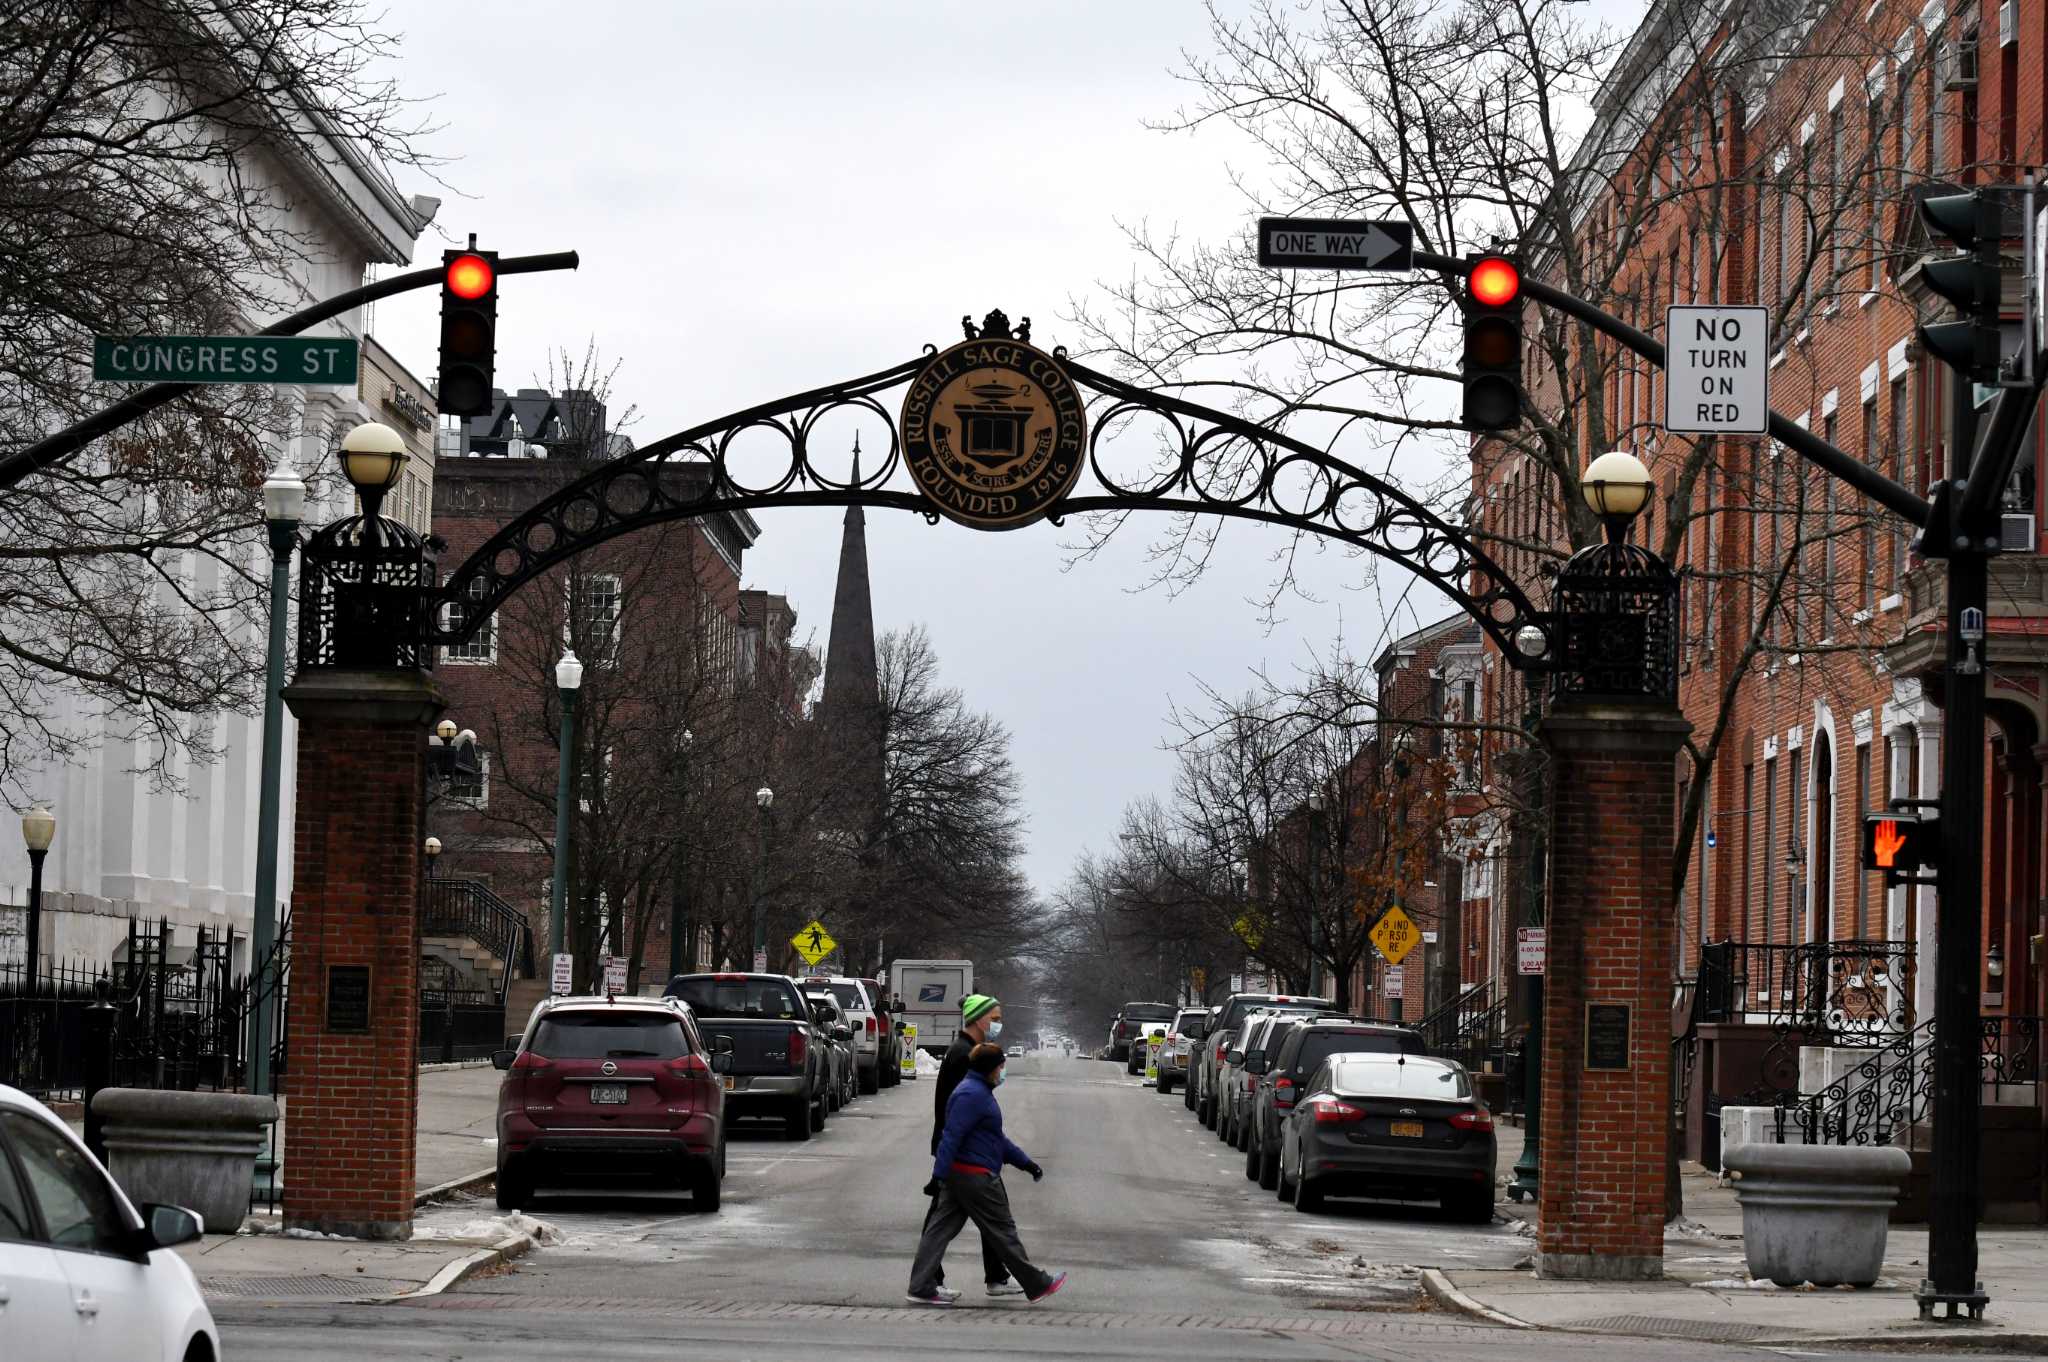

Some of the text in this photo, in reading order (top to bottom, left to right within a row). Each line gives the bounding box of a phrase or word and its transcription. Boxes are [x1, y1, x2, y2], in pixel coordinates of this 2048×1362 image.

[1276, 234, 1366, 254] ONE WAY
[1695, 317, 1741, 342] NO
[111, 344, 340, 375] CONGRESS ST
[1688, 349, 1747, 369] TURN
[1701, 376, 1734, 395] ON
[907, 346, 1080, 450] RUSSELL SAGE COLLEGE
[1696, 403, 1740, 423] RED
[935, 437, 958, 467] ESSE
[915, 456, 1068, 514] FOUNDED 1916
[1383, 919, 1409, 930] BIND
